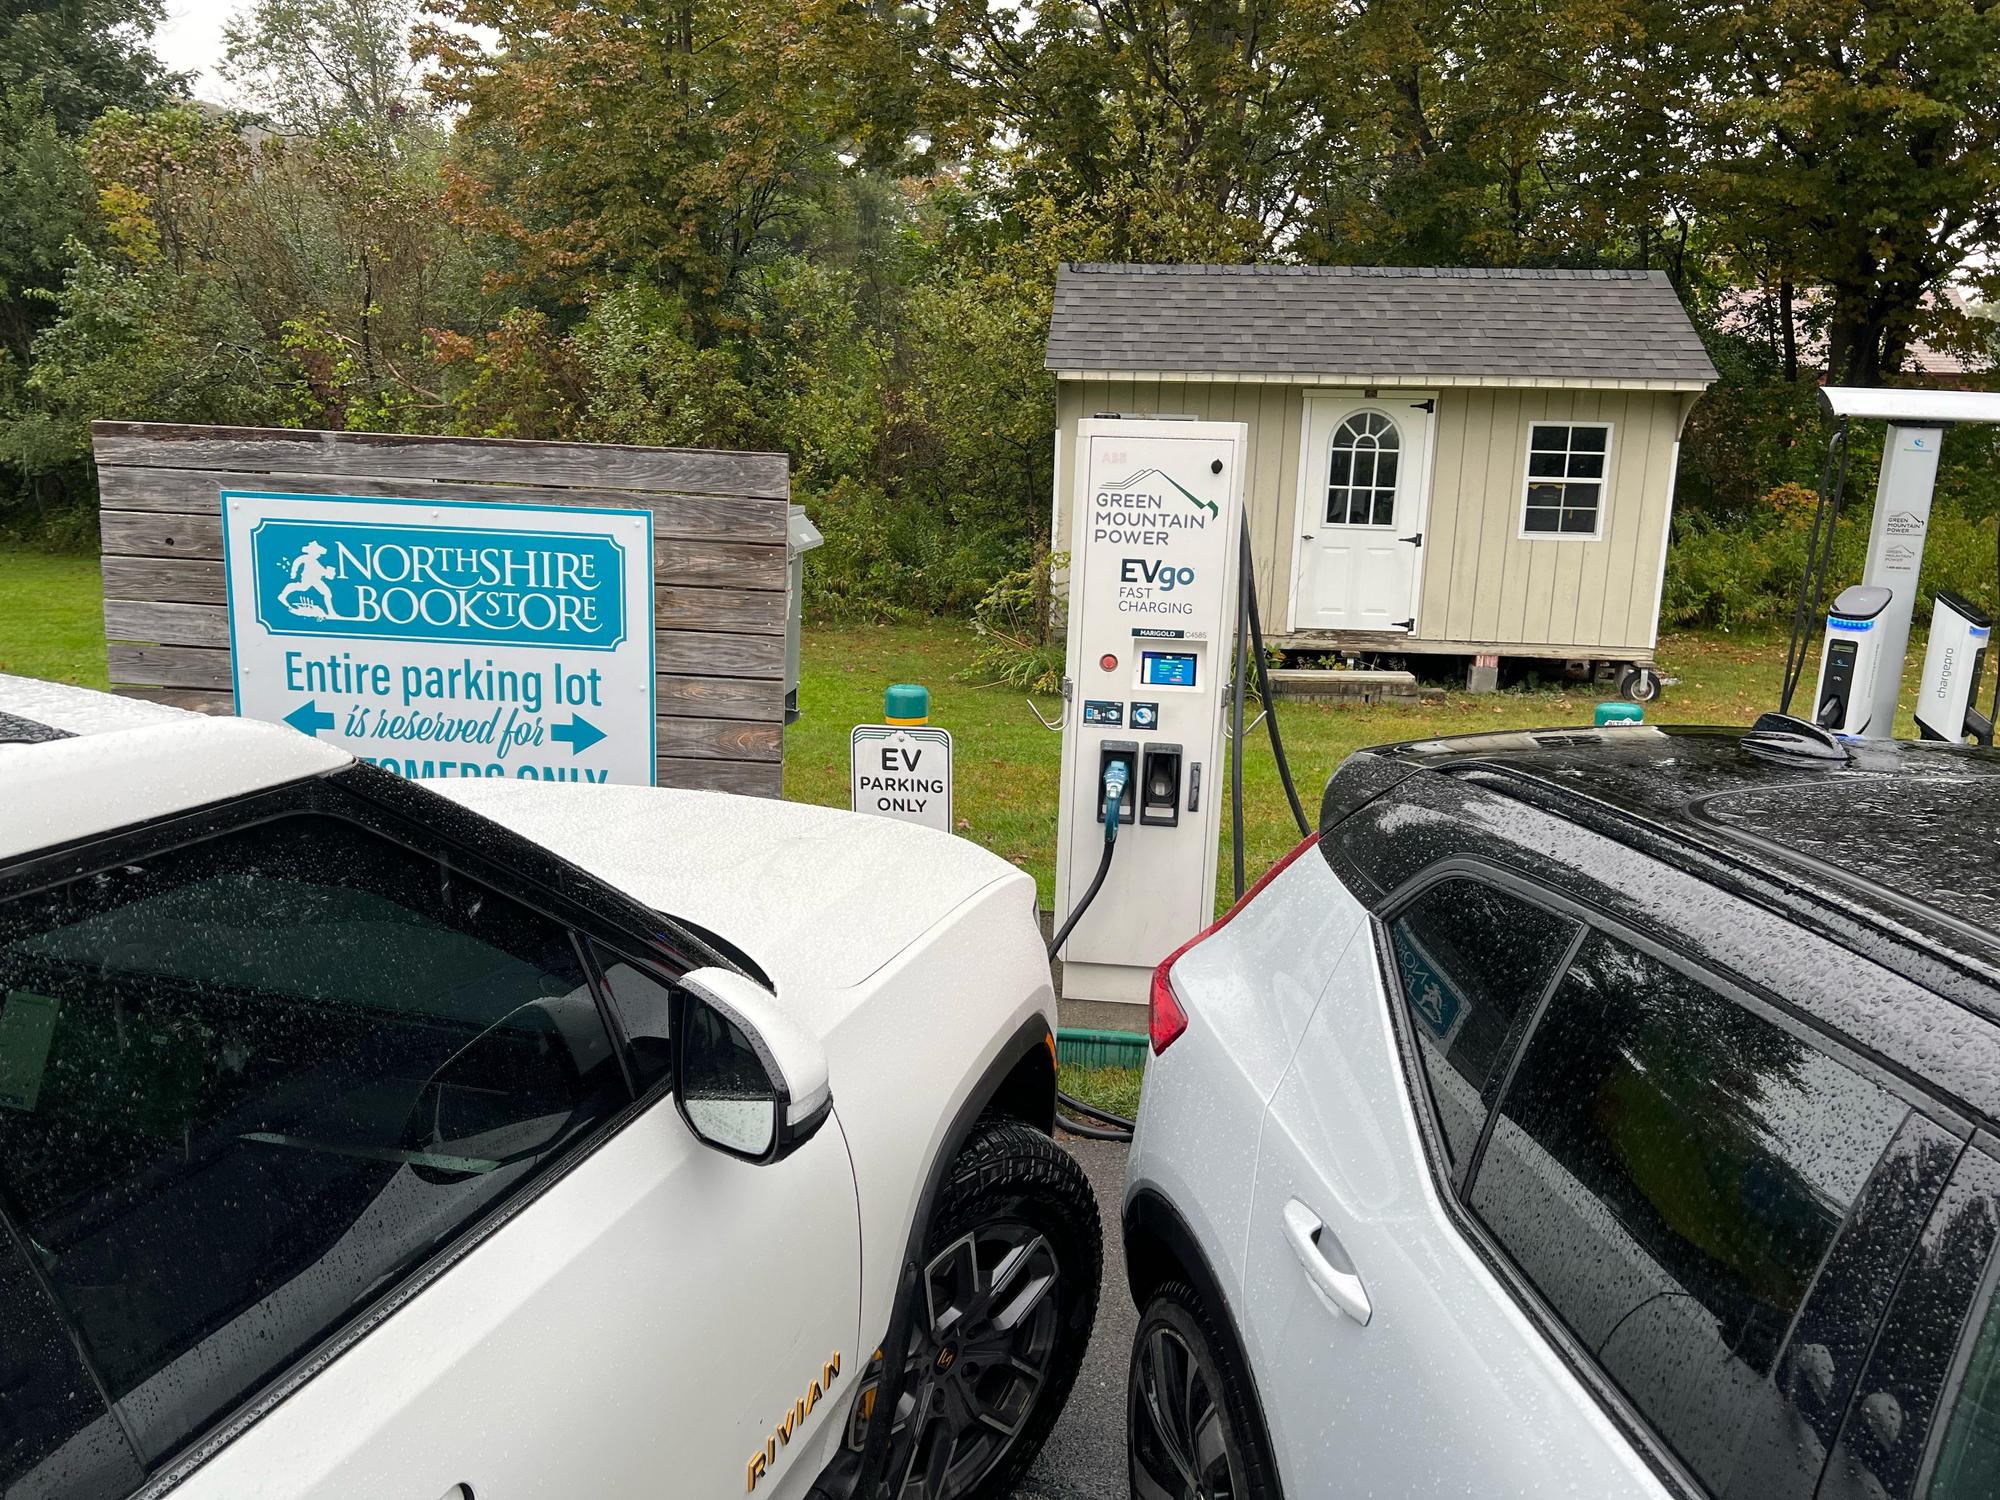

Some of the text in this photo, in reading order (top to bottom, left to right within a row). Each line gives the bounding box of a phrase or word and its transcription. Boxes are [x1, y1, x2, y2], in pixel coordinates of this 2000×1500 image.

[1096, 492, 1162, 509] GREEN
[1095, 511, 1205, 529] MOUNTAIN
[1094, 529, 1169, 546] POWER
[335, 541, 601, 590] NORTHSHIRE
[1121, 558, 1195, 592] EVgo
[1119, 587, 1153, 599] FAST
[354, 585, 603, 633] BOOKSTORE
[1118, 601, 1193, 615] CHARGING
[1140, 629, 1176, 637] MARIGOLD
[285, 651, 602, 713] Entire parking lot
[1936, 647, 1954, 699] chargepro
[344, 704, 544, 759] is reserved for
[881, 748, 922, 772] EV
[860, 776, 944, 794] PARKING
[877, 797, 927, 813] ONLY
[747, 1350, 840, 1492] RIVIAN
